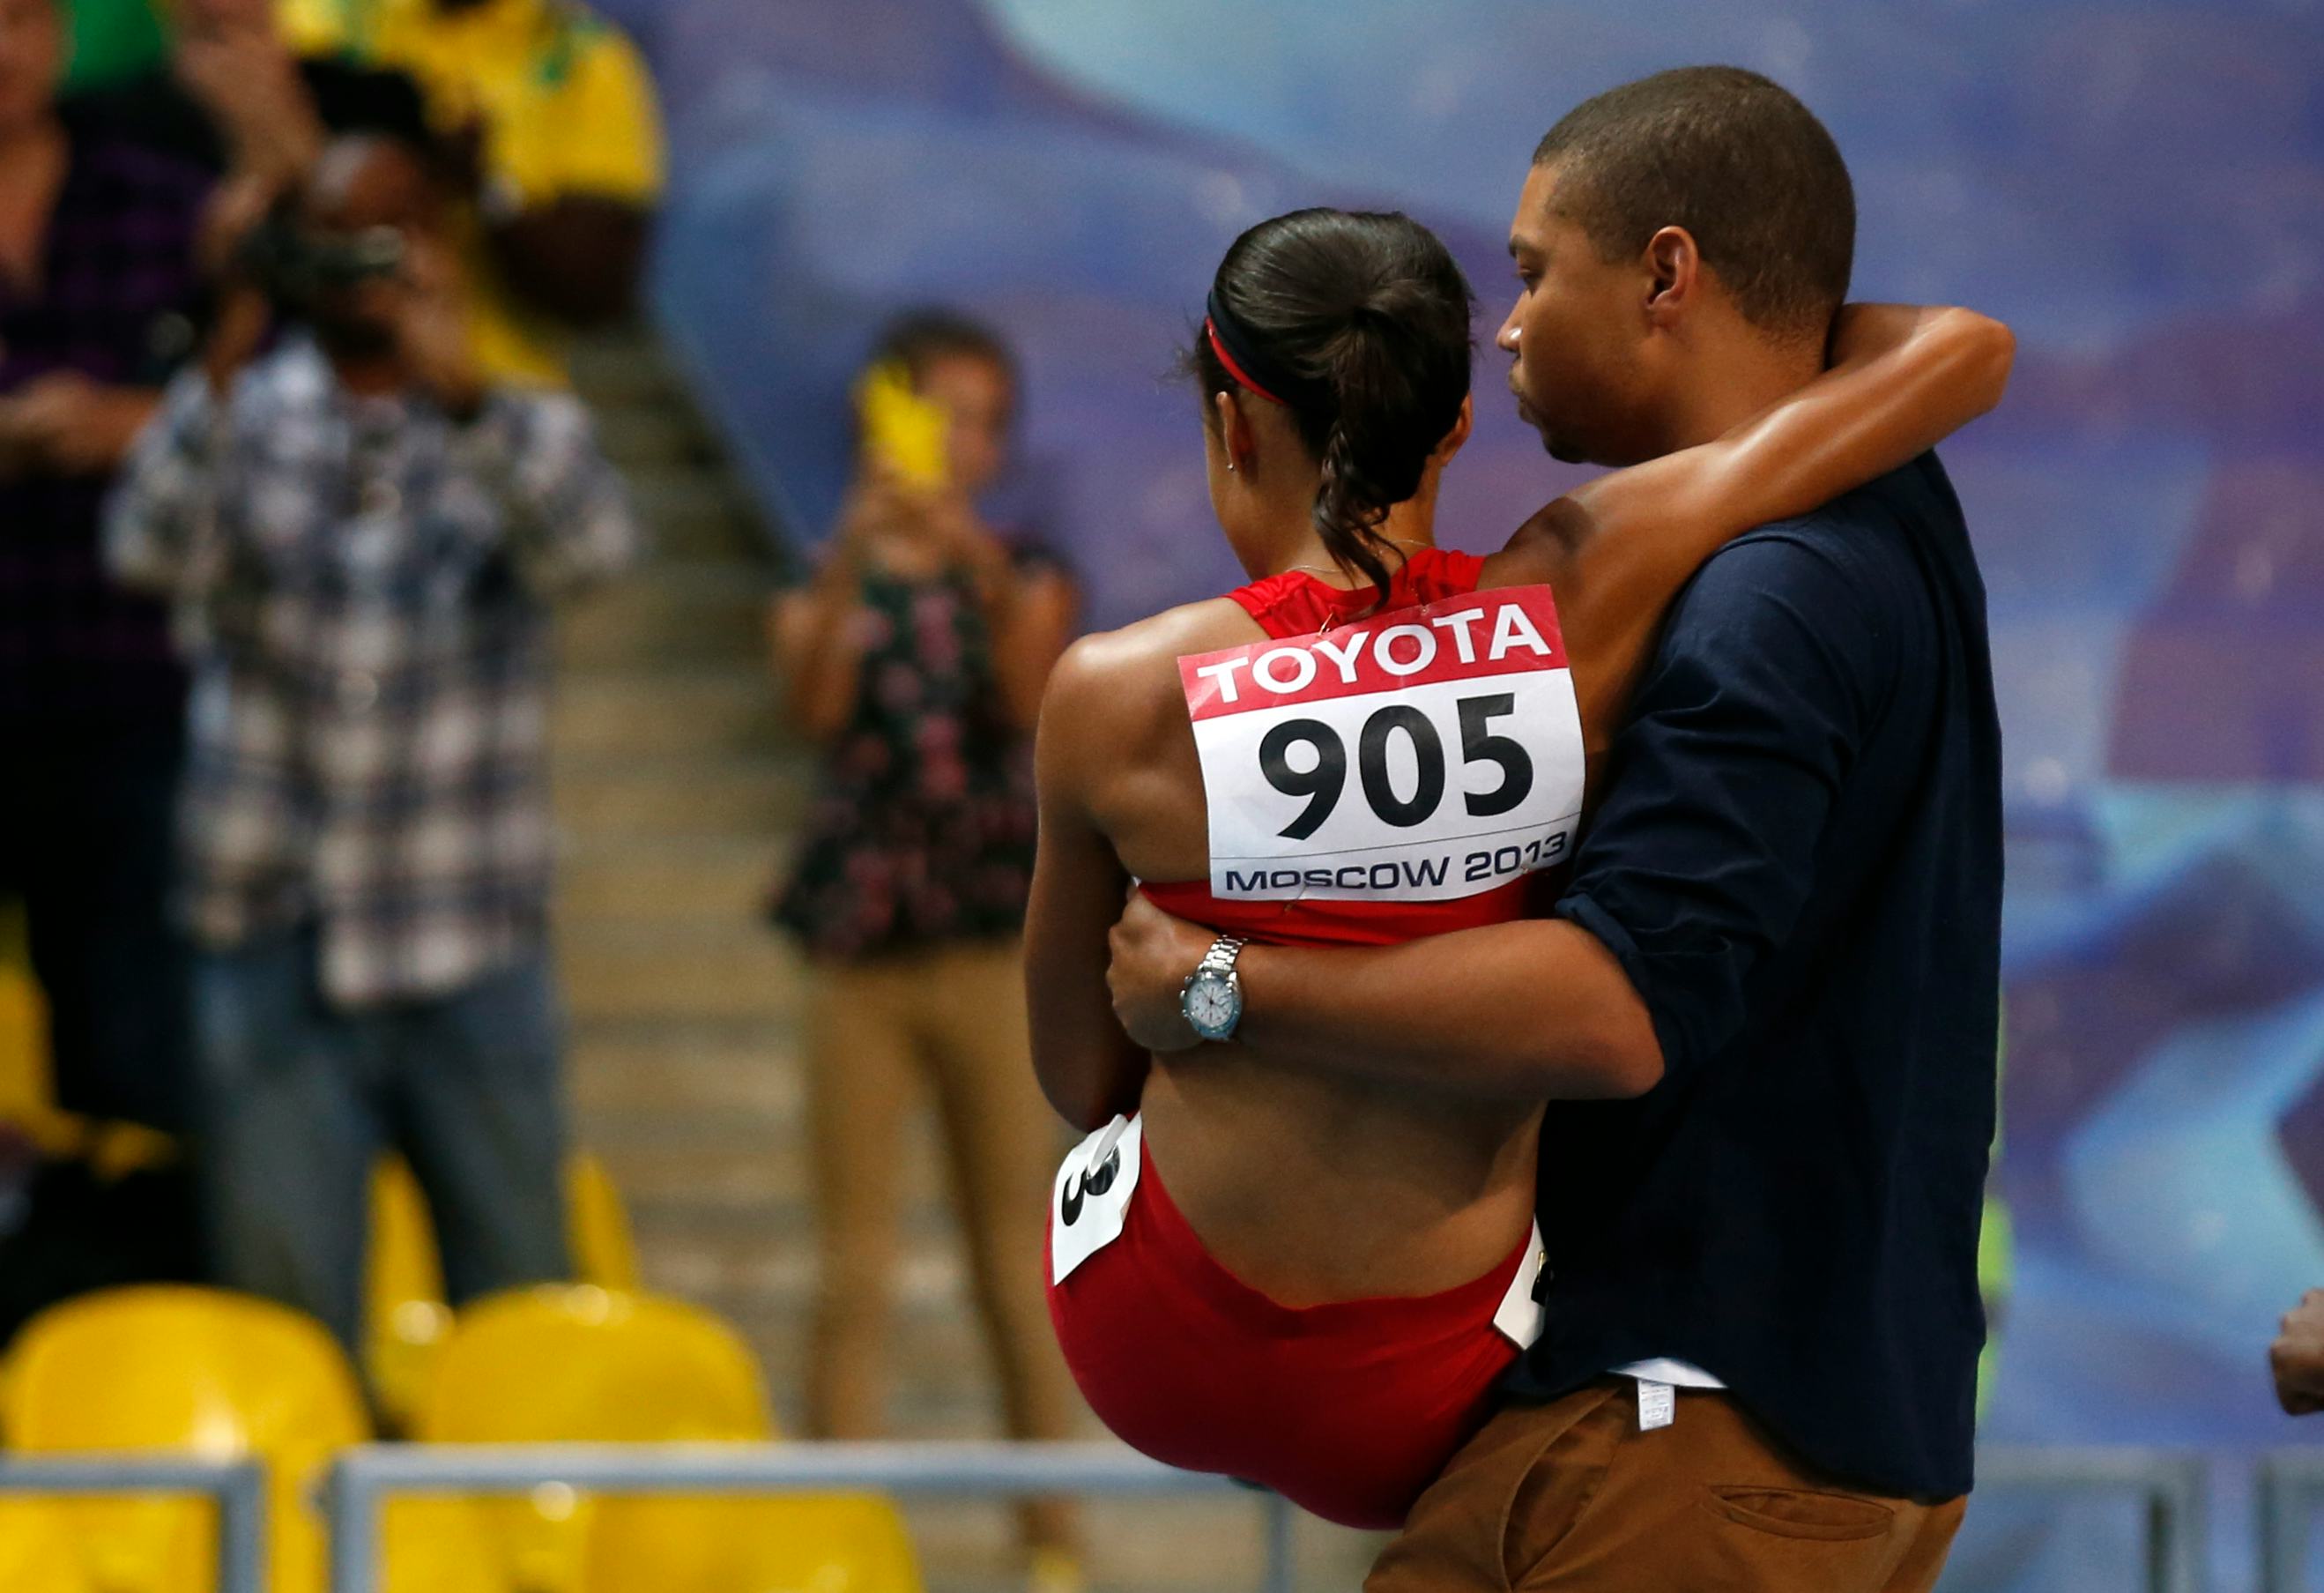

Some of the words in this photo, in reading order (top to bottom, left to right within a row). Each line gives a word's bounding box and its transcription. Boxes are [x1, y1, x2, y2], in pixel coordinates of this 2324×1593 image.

[1197, 603, 1552, 704] TOYOTA
[1258, 691, 1534, 841] 905
[1464, 830, 1568, 882] 2013
